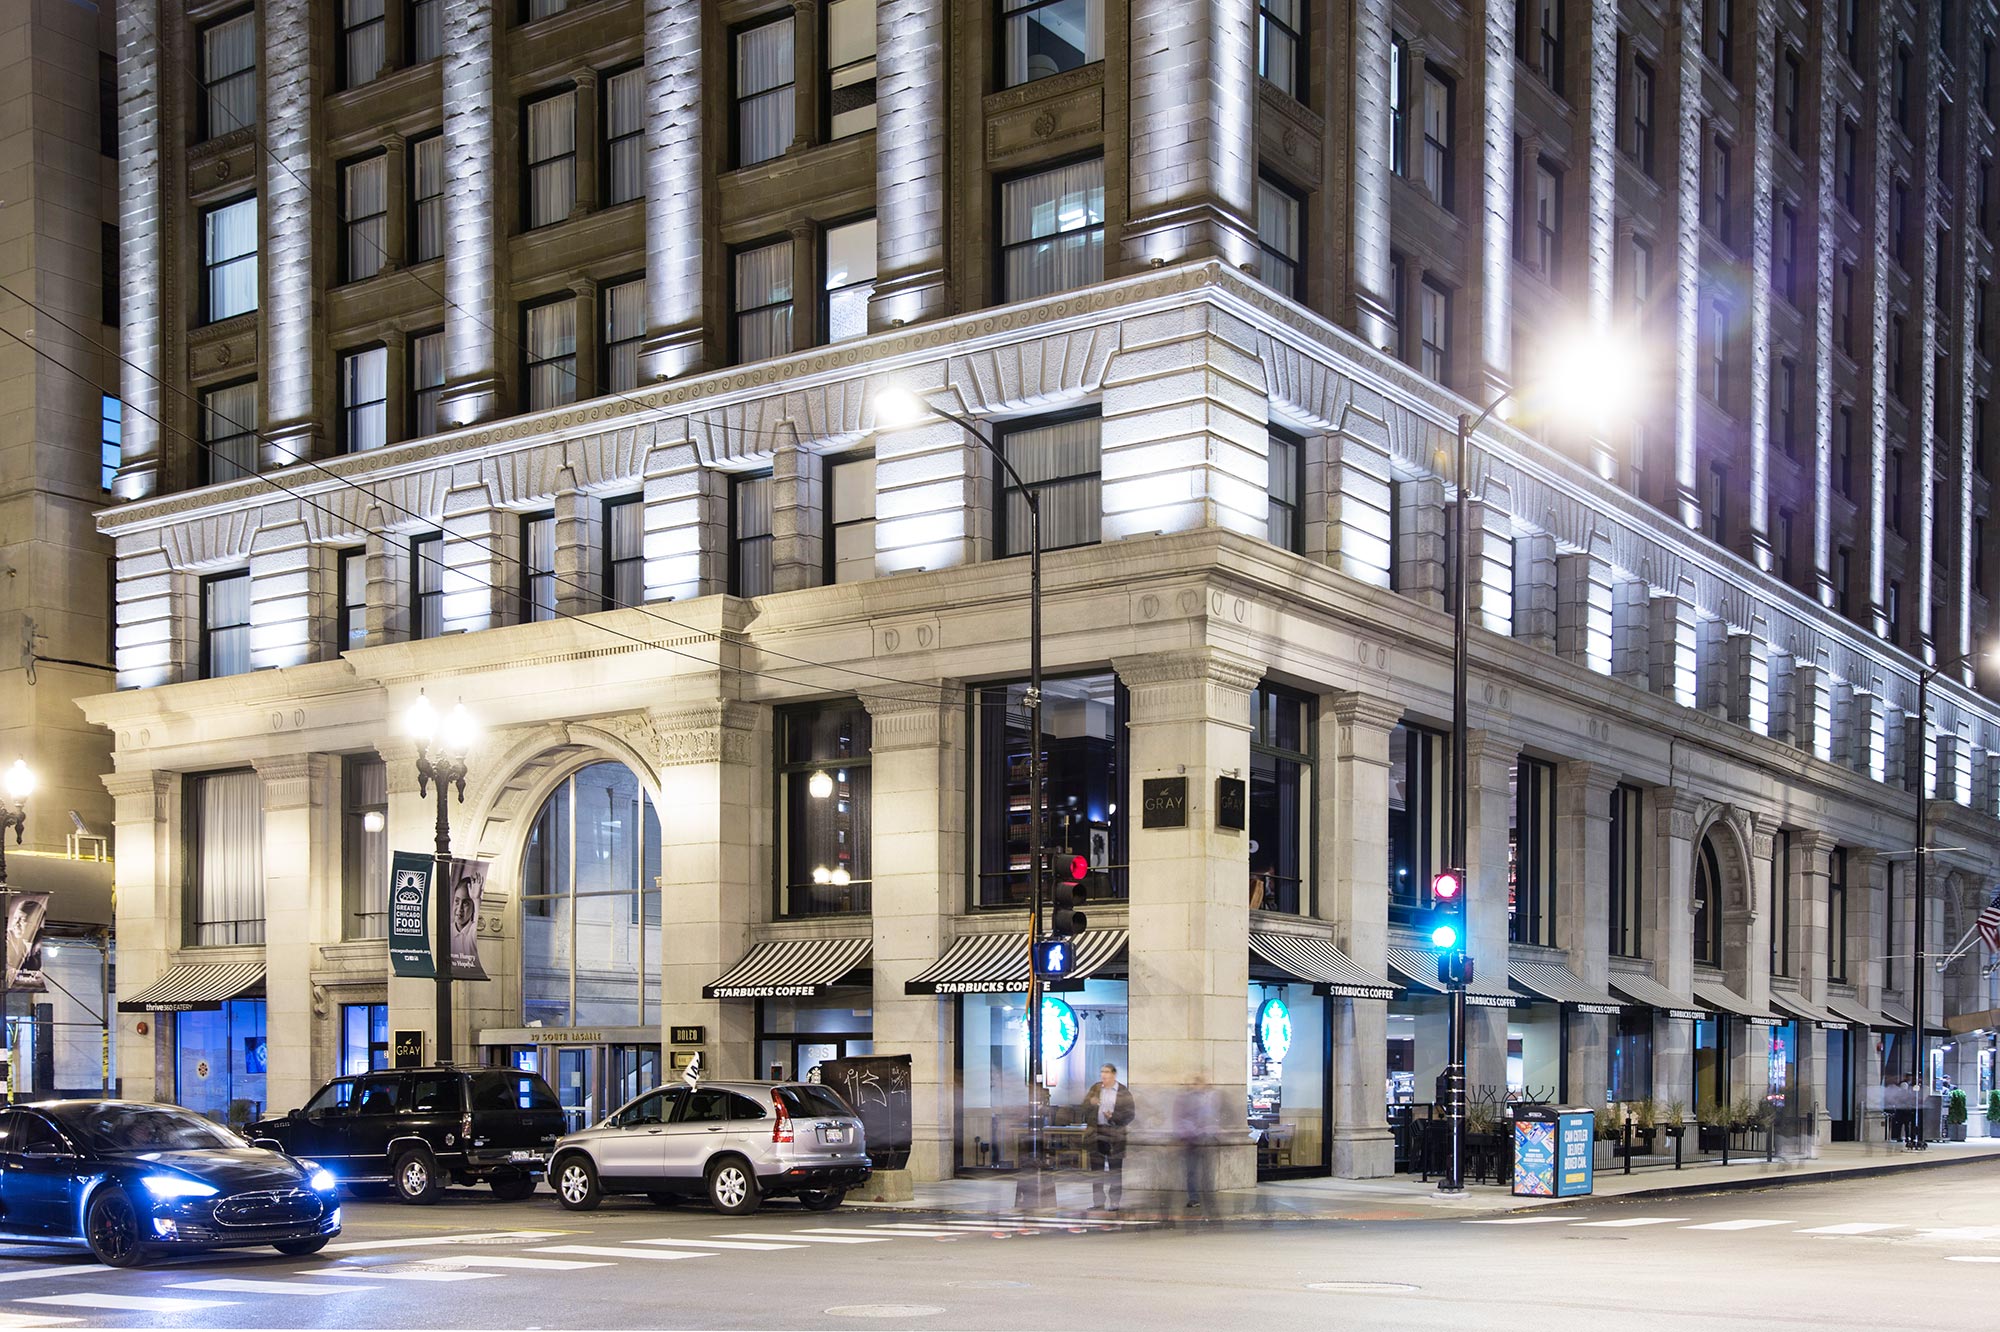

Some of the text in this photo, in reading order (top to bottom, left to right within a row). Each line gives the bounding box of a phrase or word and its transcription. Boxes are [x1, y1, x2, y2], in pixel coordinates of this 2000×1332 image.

[1145, 797, 1183, 811] GRAY
[1221, 796, 1243, 811] GRAY
[396, 904, 420, 912] GREATER
[396, 911, 420, 919] CHICAGO
[396, 918, 420, 928] FOOD
[713, 986, 814, 998] STARBUCKS COFFEE
[935, 981, 1051, 993] STARBUCKS COFE
[1330, 985, 1393, 999] STARBUCKS COFFEE
[173, 1003, 193, 1011] EATERY
[1465, 996, 1516, 1008] STARBUCKS COFFEE
[1578, 1004, 1620, 1014] STARBUCKS COFFEE
[543, 1033, 568, 1042] SOUTH
[396, 1045, 421, 1056] GRAY
